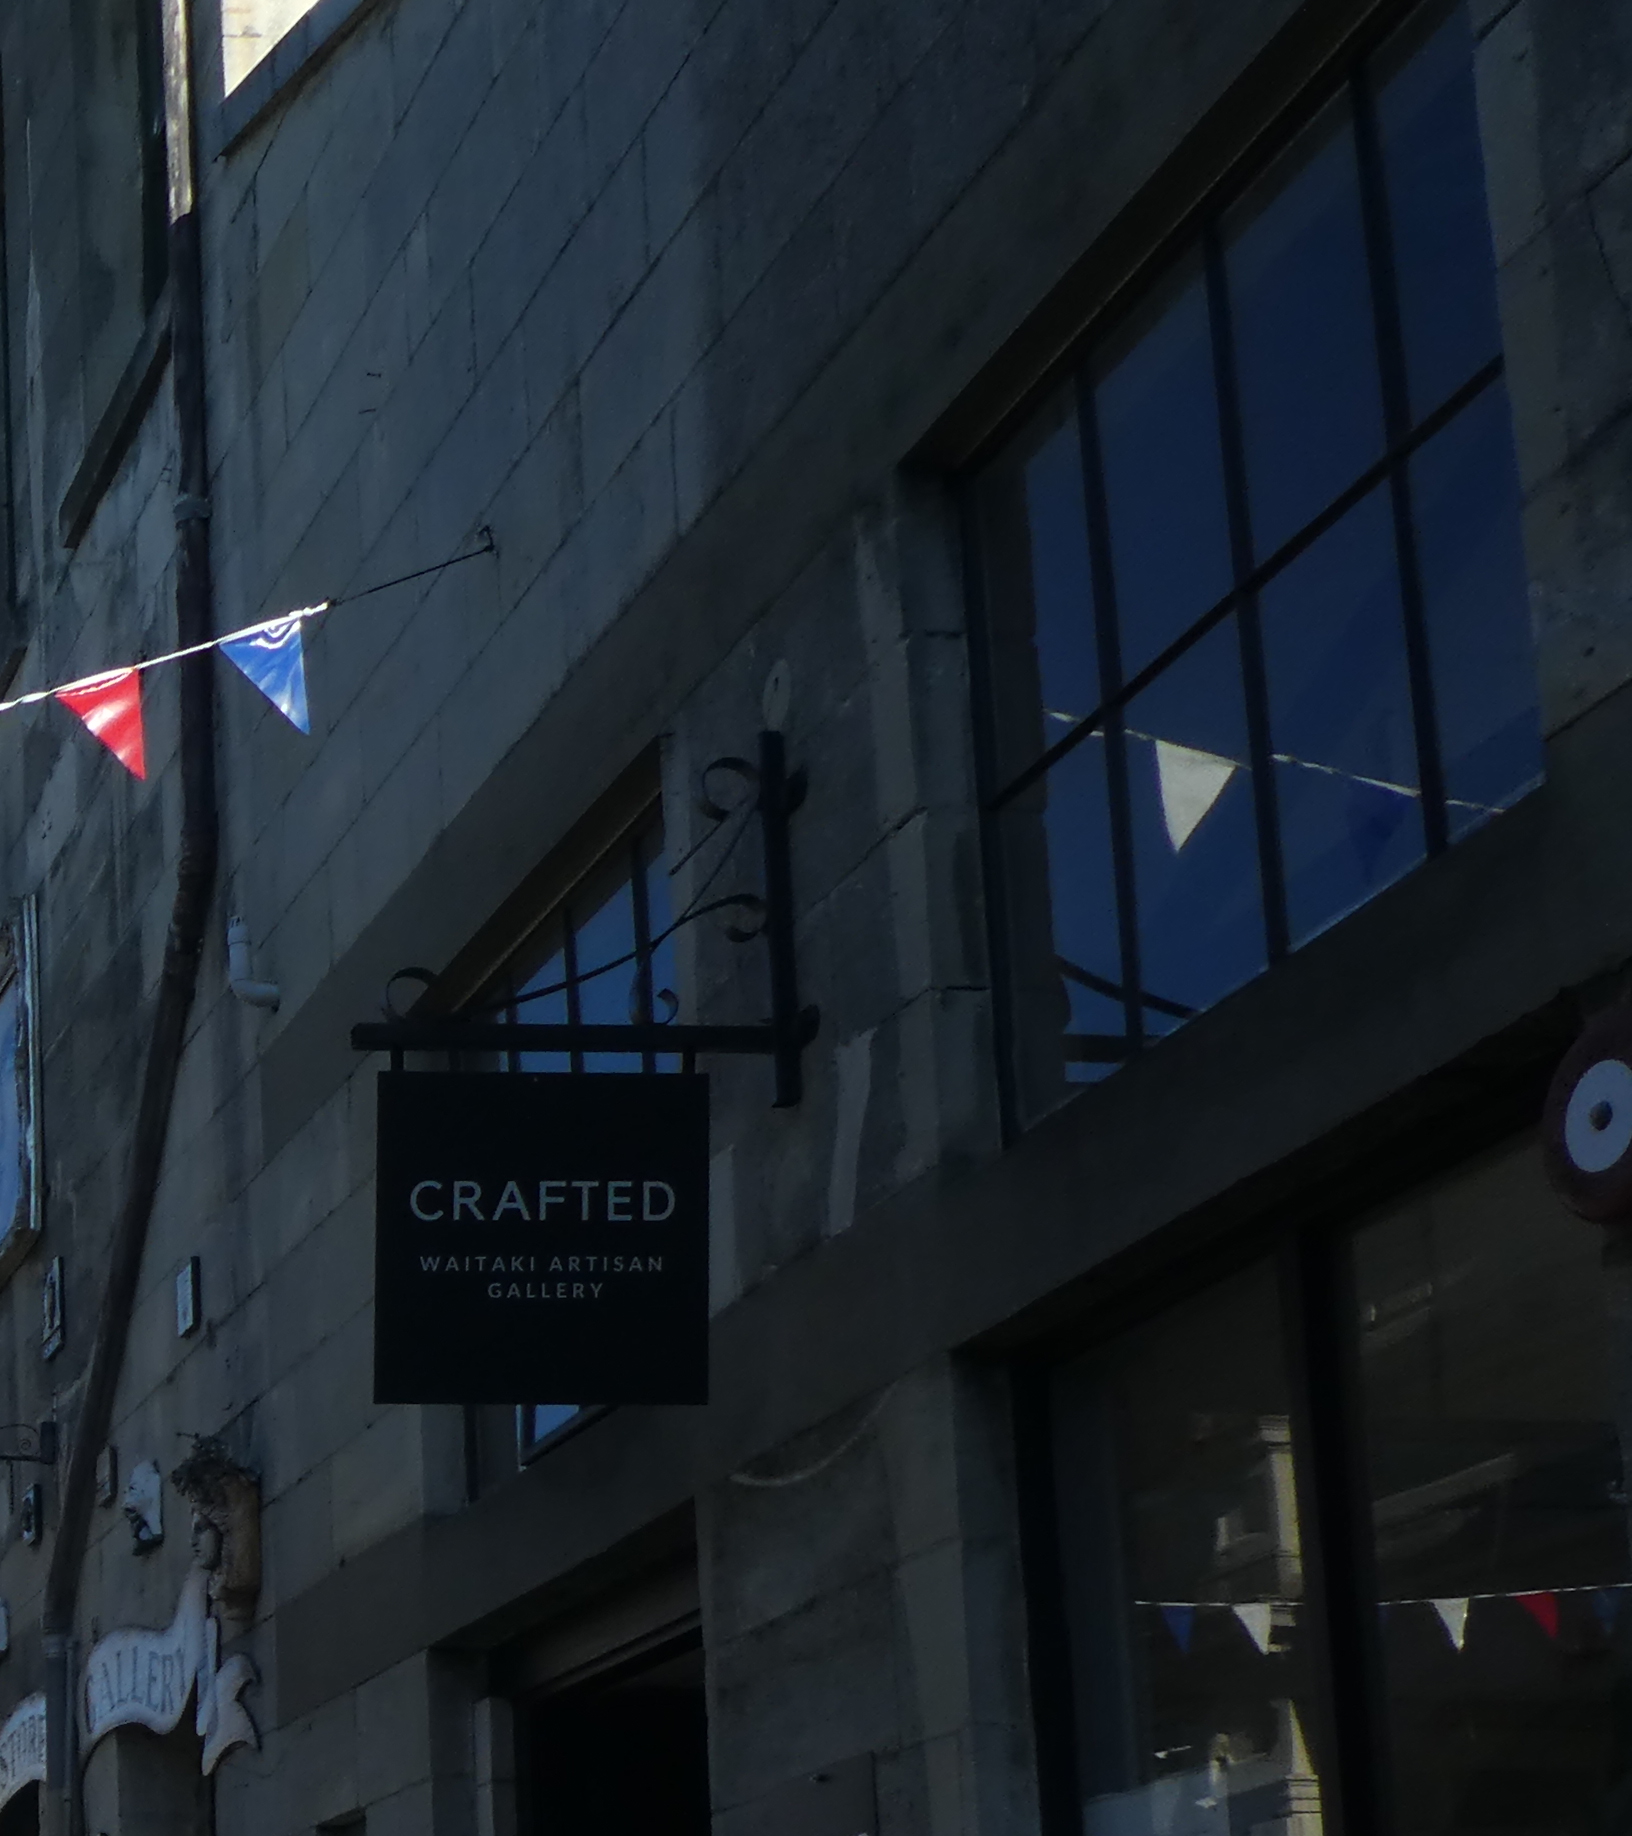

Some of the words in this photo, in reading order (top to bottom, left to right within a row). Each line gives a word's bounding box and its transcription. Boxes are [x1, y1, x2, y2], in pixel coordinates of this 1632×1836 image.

[409, 1180, 676, 1222] CRAFTED
[419, 1255, 536, 1273] WAITAKI
[549, 1255, 664, 1273] ARTISAN
[487, 1282, 606, 1299] GALLERY
